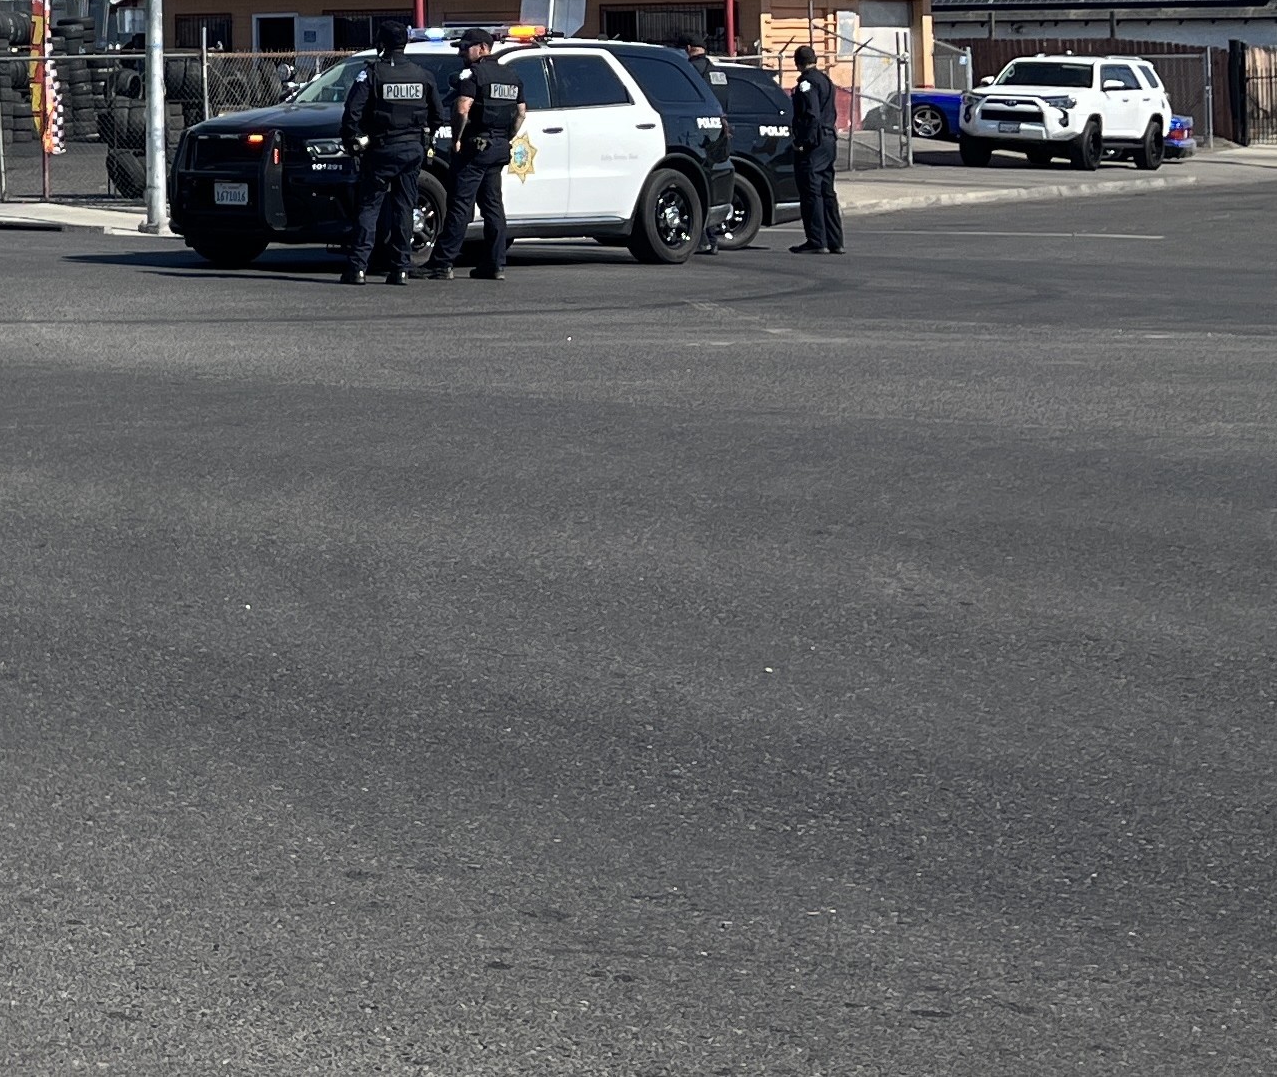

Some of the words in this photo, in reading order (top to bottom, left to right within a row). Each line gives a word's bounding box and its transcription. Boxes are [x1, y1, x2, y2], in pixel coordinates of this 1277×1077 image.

[386, 84, 421, 99] POLICE
[493, 83, 518, 99] POLICE
[696, 116, 723, 130] POLICE
[759, 125, 790, 137] POLIC
